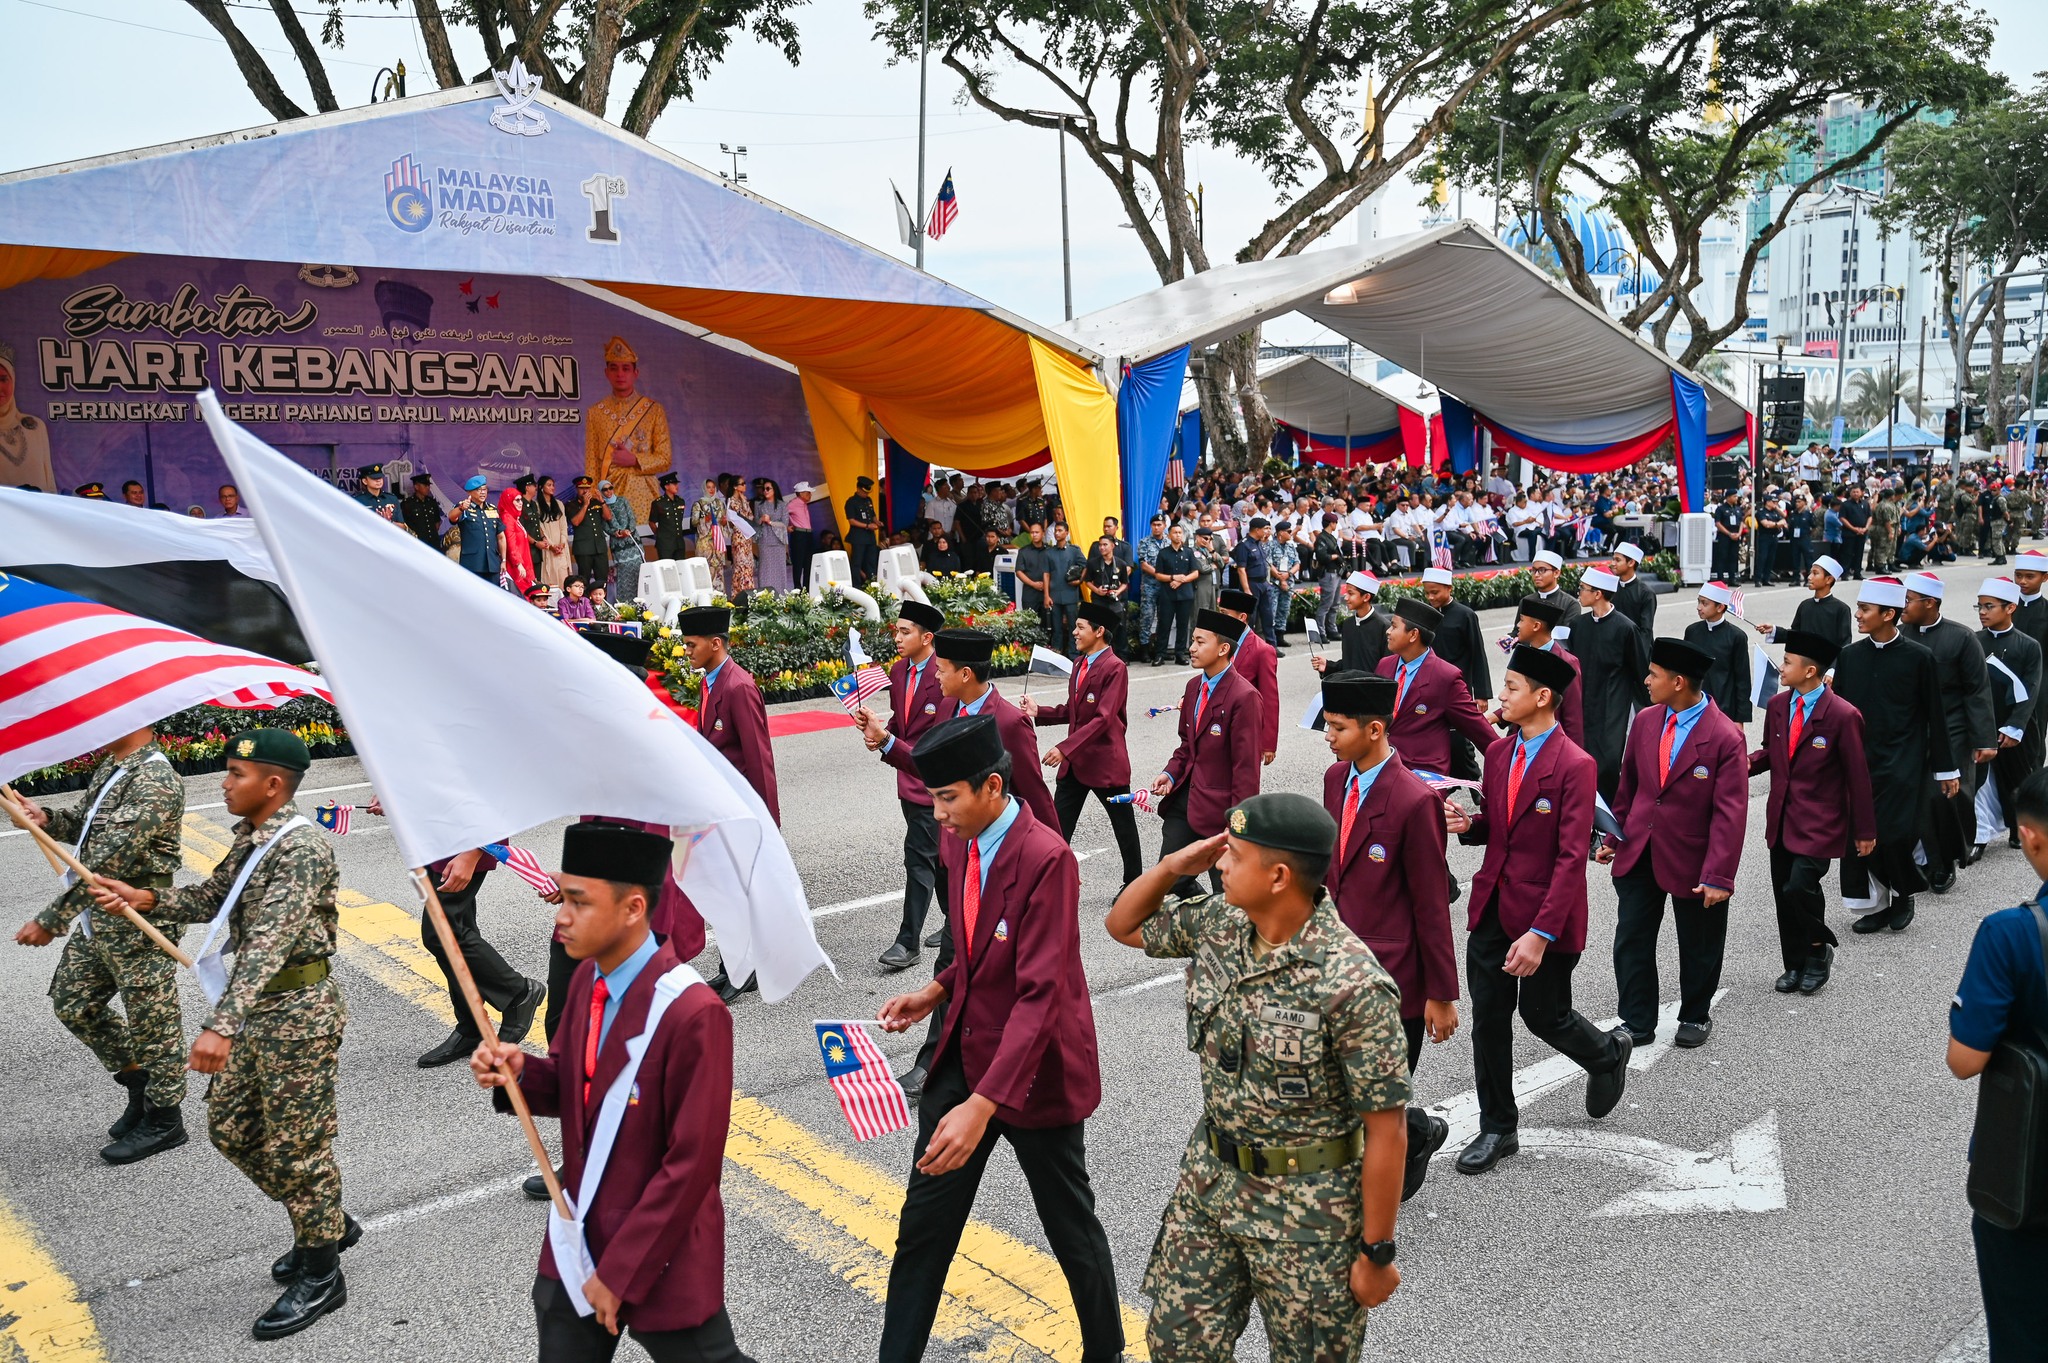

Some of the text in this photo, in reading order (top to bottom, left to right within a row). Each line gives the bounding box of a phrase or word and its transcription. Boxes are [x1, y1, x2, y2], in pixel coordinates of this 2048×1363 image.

[437, 167, 553, 196] MALAYSIA
[439, 188, 556, 220] MADANI
[438, 211, 557, 236] Rakyat Disantuni
[62, 283, 318, 338] Sambutan
[38, 337, 580, 399] HARI KEBANGSAAN
[48, 401, 581, 425] PERINGKAT GERI PAHANG DARUL MAKMUR 2025
[1274, 1009, 1306, 1024] RAMD
